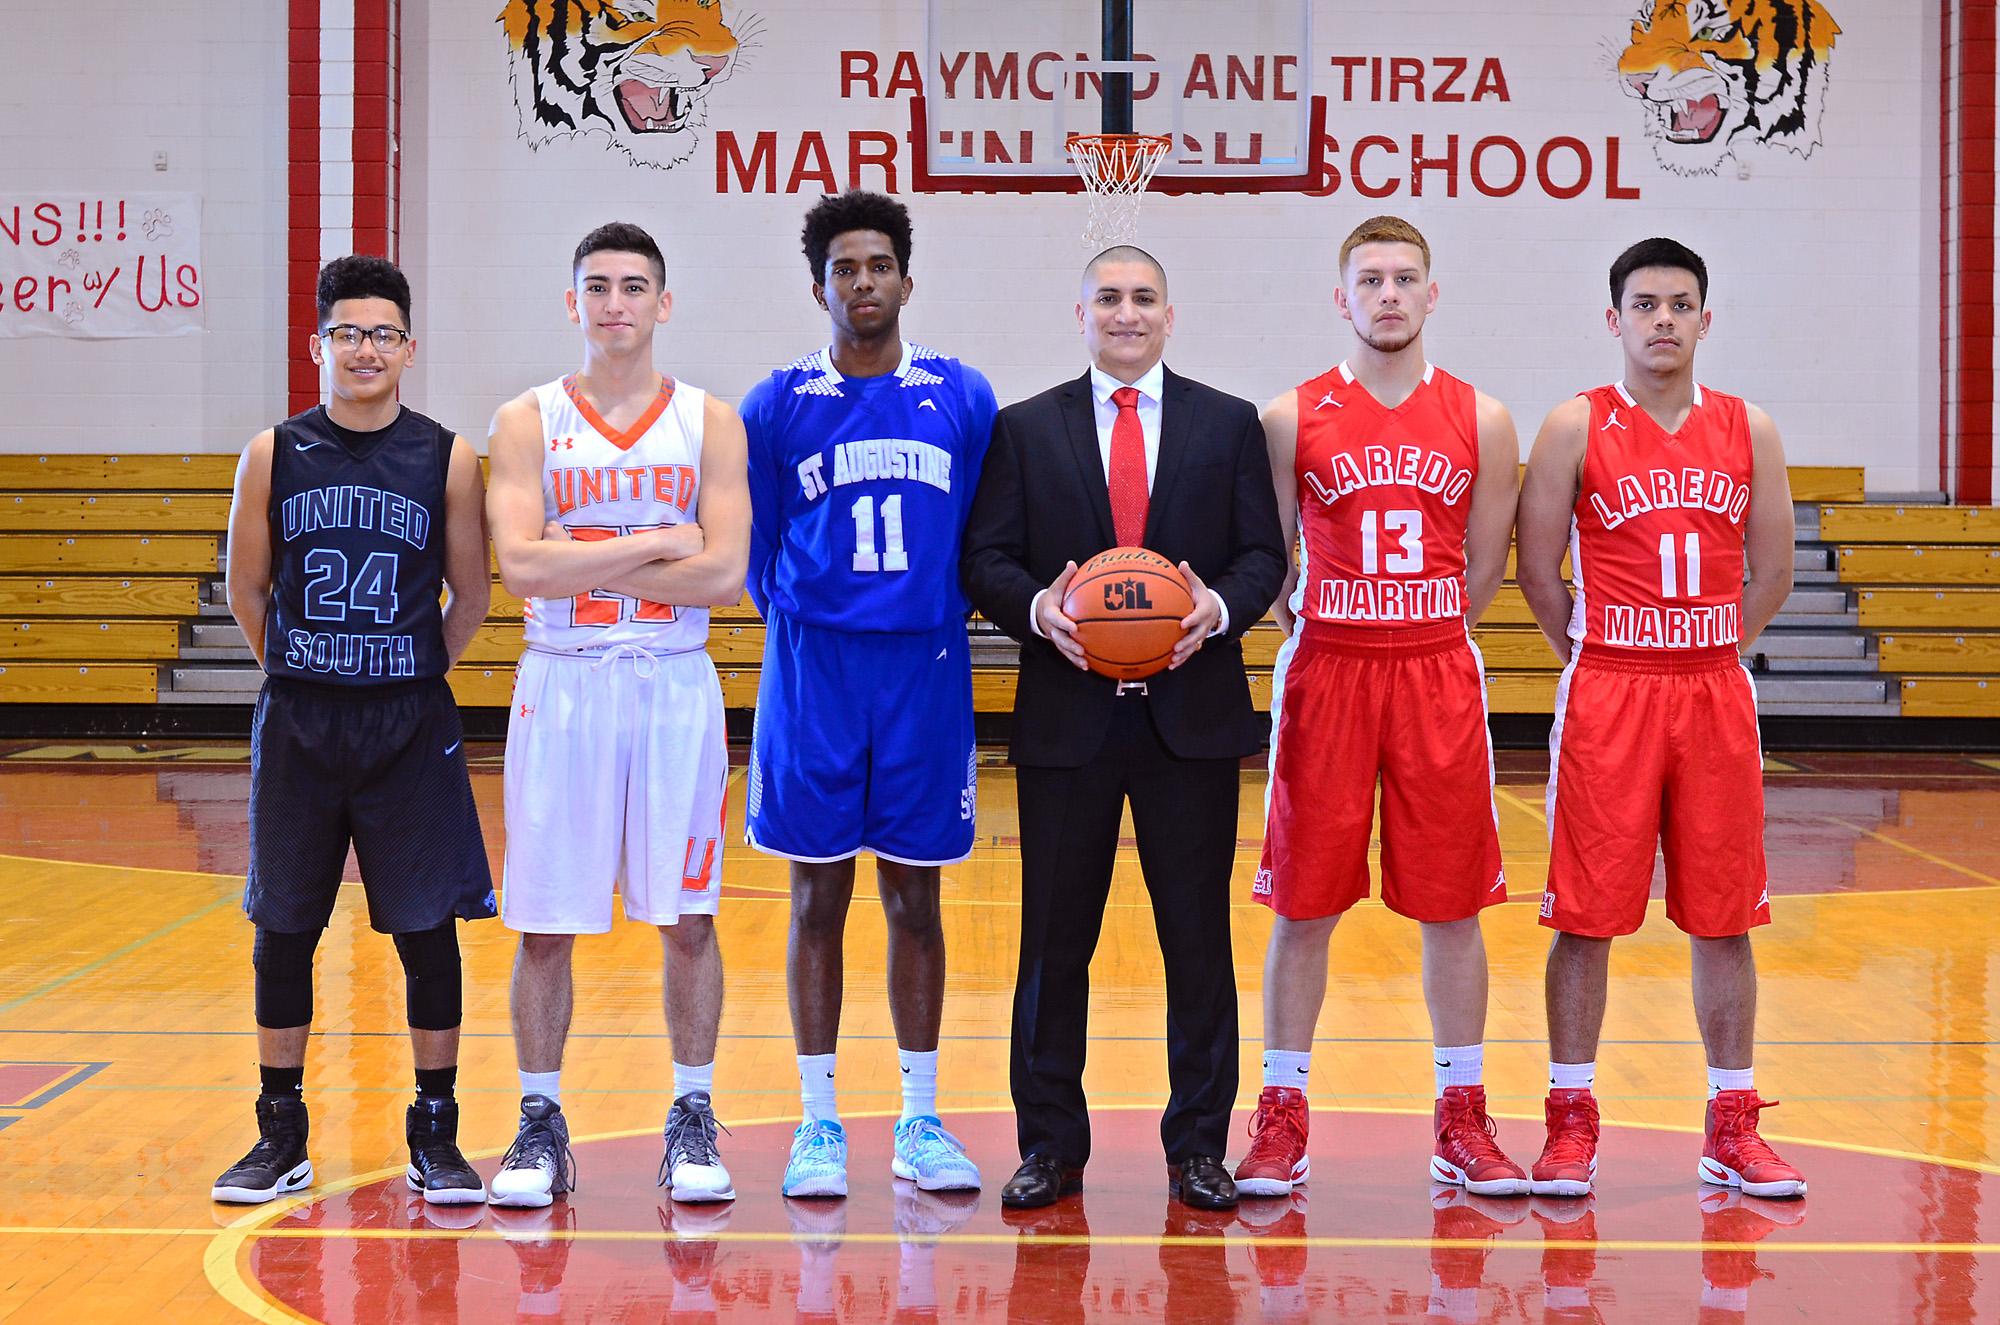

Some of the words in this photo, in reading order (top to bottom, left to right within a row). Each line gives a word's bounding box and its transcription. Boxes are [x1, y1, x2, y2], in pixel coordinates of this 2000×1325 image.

[1184, 54, 1298, 102] AND
[1331, 56, 1511, 103] TIRZA
[0, 276, 71, 312] er
[136, 255, 200, 312] Us
[549, 463, 697, 518] UNITED
[797, 452, 829, 502] ST
[833, 438, 952, 495] AUGUSTINE
[1304, 445, 1472, 506] LAREDO
[1590, 467, 1750, 531] LAREDO
[282, 485, 430, 551] UNITED
[851, 494, 909, 572] 11
[1360, 509, 1424, 575] 13
[304, 548, 399, 624] 24
[1658, 532, 1701, 598] 11
[1318, 576, 1461, 621] MARTIN
[1604, 603, 1739, 649] MARTIN
[285, 628, 415, 677] SOUTH
[681, 836, 717, 893] U
